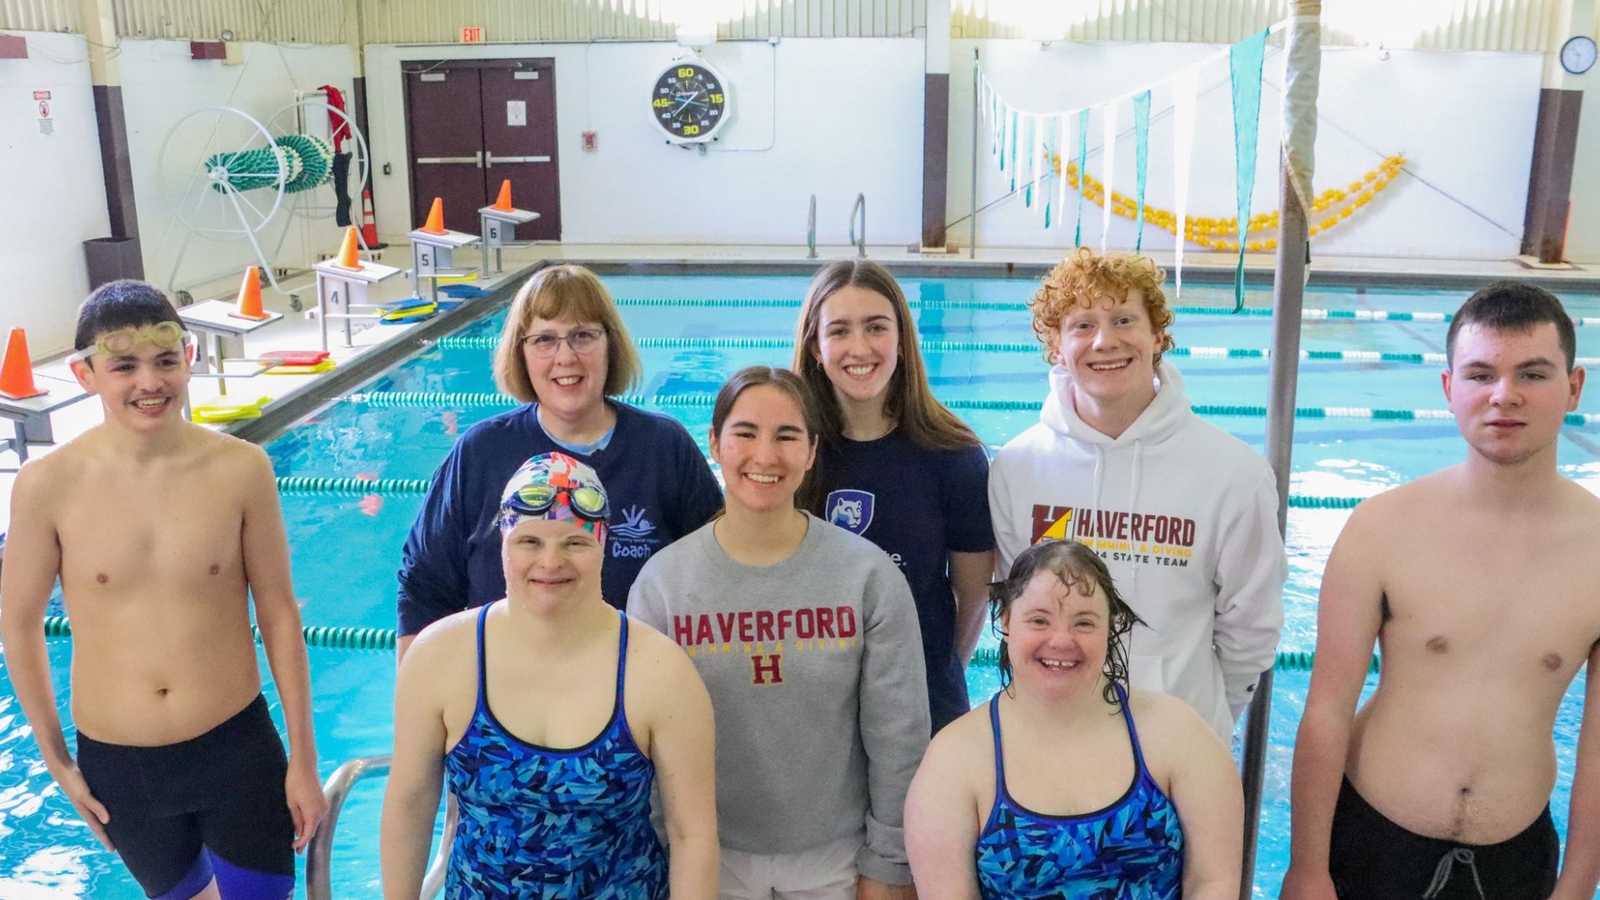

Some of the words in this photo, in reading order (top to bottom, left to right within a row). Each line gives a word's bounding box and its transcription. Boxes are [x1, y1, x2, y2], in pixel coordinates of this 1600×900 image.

[463, 28, 481, 42] EXIT
[678, 68, 694, 78] 60
[653, 99, 668, 107] 45
[710, 94, 723, 103] 15
[684, 125, 699, 135] 30
[490, 228, 497, 239] 6
[421, 253, 429, 267] 5
[330, 291, 339, 305] 4
[1077, 508, 1196, 548] HAVERFORD
[612, 541, 651, 558] Coach
[1152, 545, 1192, 558] DIVING
[1113, 552, 1150, 564] STATE
[1155, 556, 1188, 567] TEAM
[673, 605, 857, 647] HAVERFORD
[751, 653, 784, 685] H
